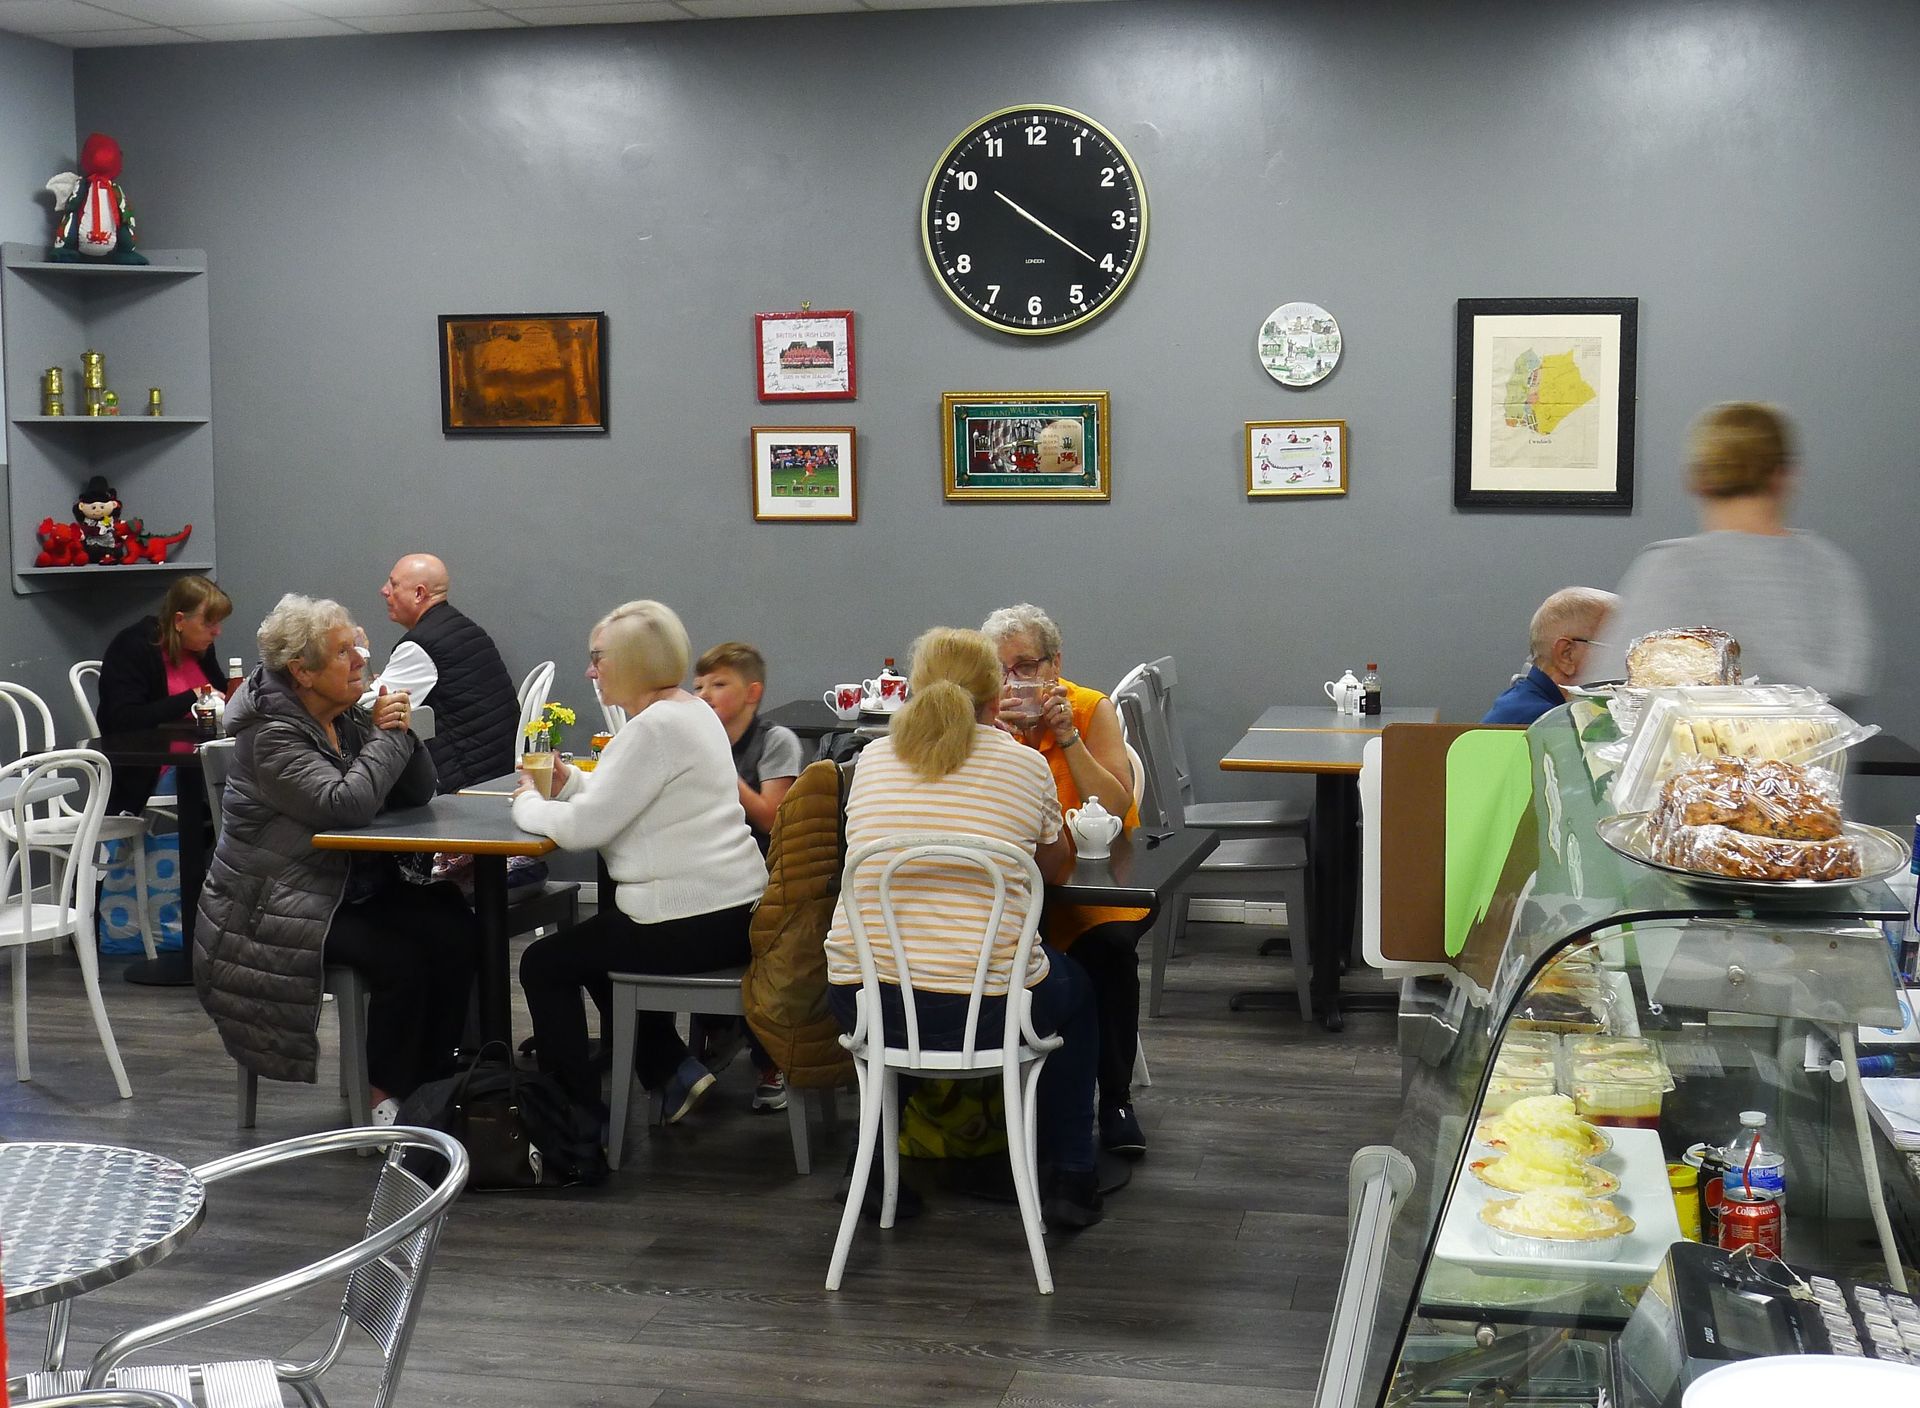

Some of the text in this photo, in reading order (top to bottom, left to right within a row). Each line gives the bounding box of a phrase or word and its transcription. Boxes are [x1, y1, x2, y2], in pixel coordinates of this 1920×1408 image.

[1025, 126, 1047, 145] 12
[985, 138, 1003, 157] 11
[1072, 137, 1082, 156] 1
[956, 171, 978, 190] 10
[1100, 168, 1115, 187] 2
[945, 212, 960, 231] 9
[1111, 210, 1126, 230] 3
[956, 254, 971, 273] 8
[1099, 253, 1115, 273] 4
[987, 285, 1001, 304] 7
[1069, 284, 1084, 303] 5
[1027, 296, 1042, 315] 6
[1010, 406, 1038, 414] WALES
